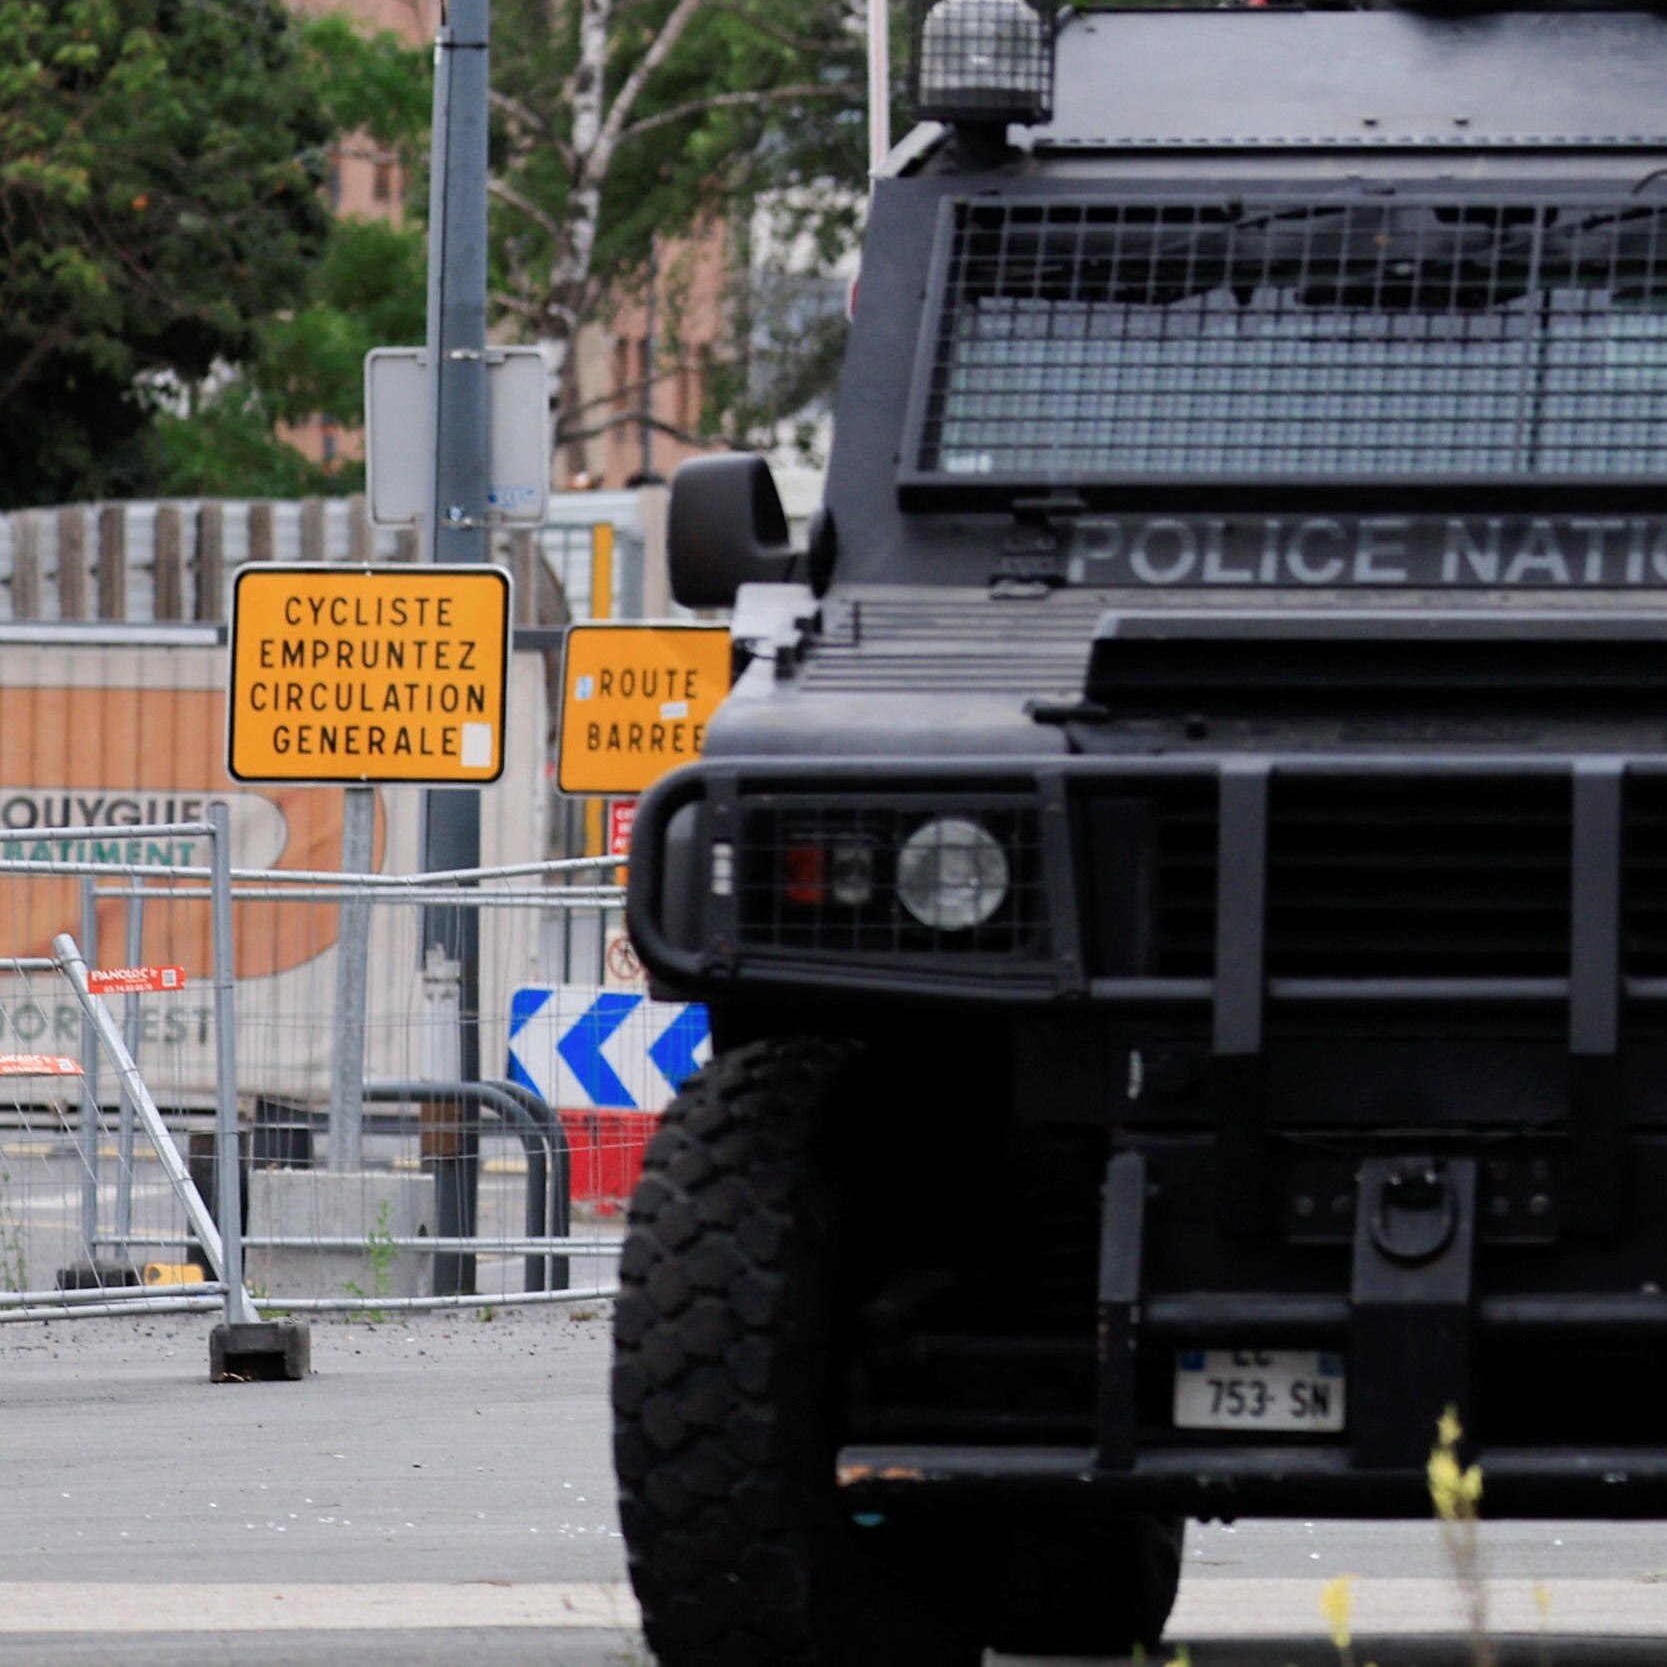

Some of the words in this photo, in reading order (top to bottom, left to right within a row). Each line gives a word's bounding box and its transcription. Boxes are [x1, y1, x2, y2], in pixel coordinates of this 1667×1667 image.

[1069, 518, 1409, 584] POLICE
[285, 596, 453, 626] CYCLISTE
[260, 639, 476, 670] EMPRUNTEZ
[251, 682, 485, 713] CIRCULATION
[600, 669, 698, 699] ROUTE
[273, 725, 456, 755] GENERALE
[2, 797, 227, 829] OUYGUE
